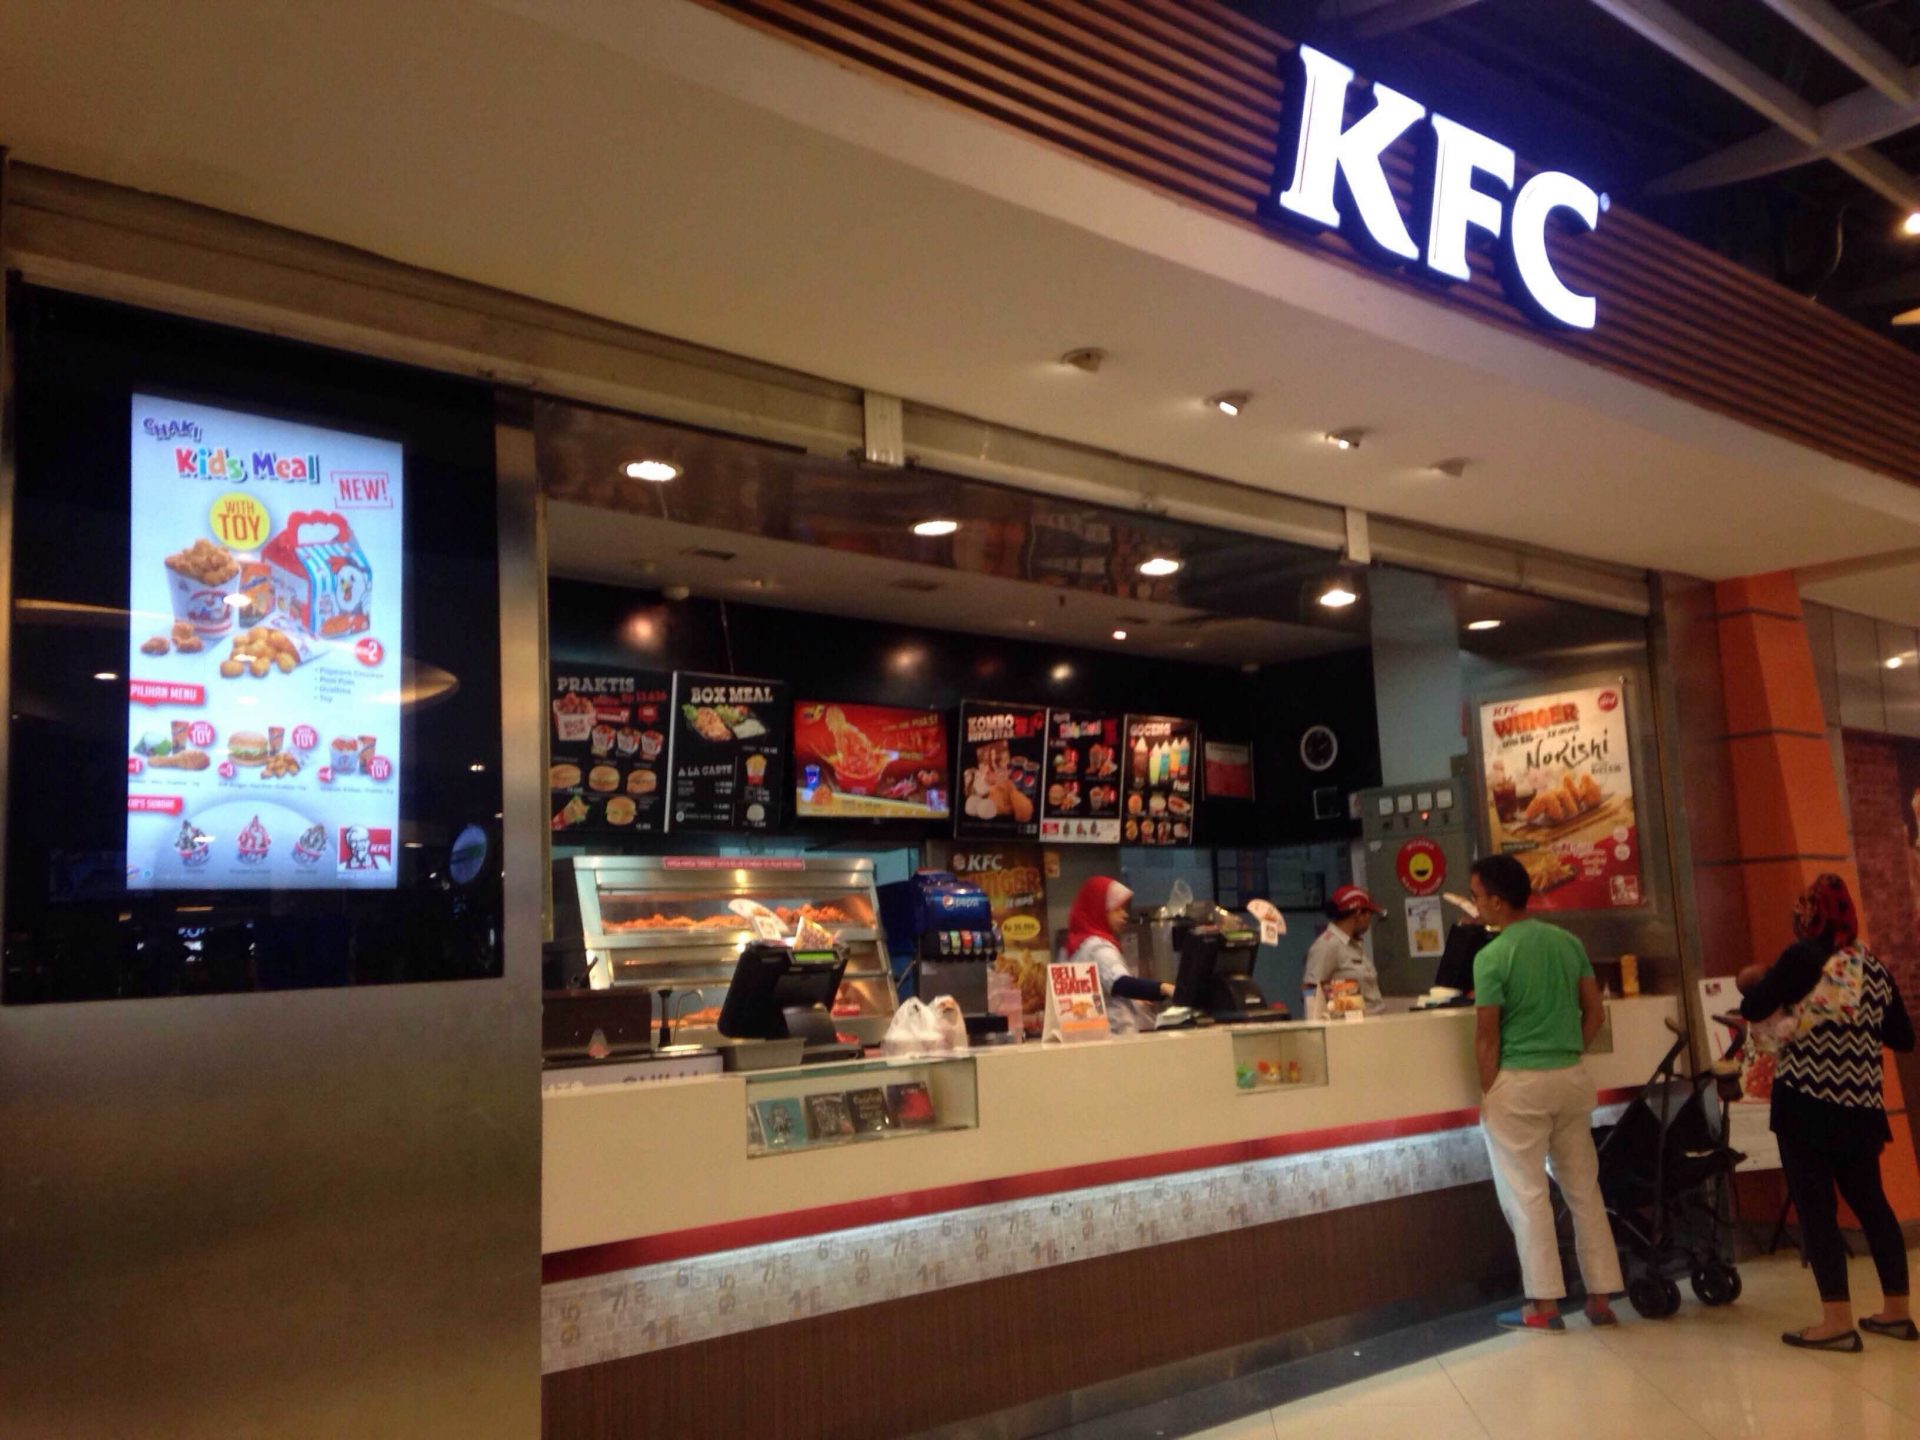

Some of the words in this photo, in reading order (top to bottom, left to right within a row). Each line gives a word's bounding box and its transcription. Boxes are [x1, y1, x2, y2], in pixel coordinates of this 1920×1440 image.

[1280, 43, 1600, 329] KFC
[252, 451, 320, 484] Meal
[339, 478, 387, 501] NEW!
[224, 500, 255, 515] WITH
[218, 514, 261, 542] TOY
[557, 677, 635, 692] PRAKTIS
[170, 687, 197, 701] MENU
[691, 687, 726, 704] BOX
[729, 686, 773, 703] MEAL
[370, 843, 390, 854] KFC
[967, 853, 1003, 871] KFC
